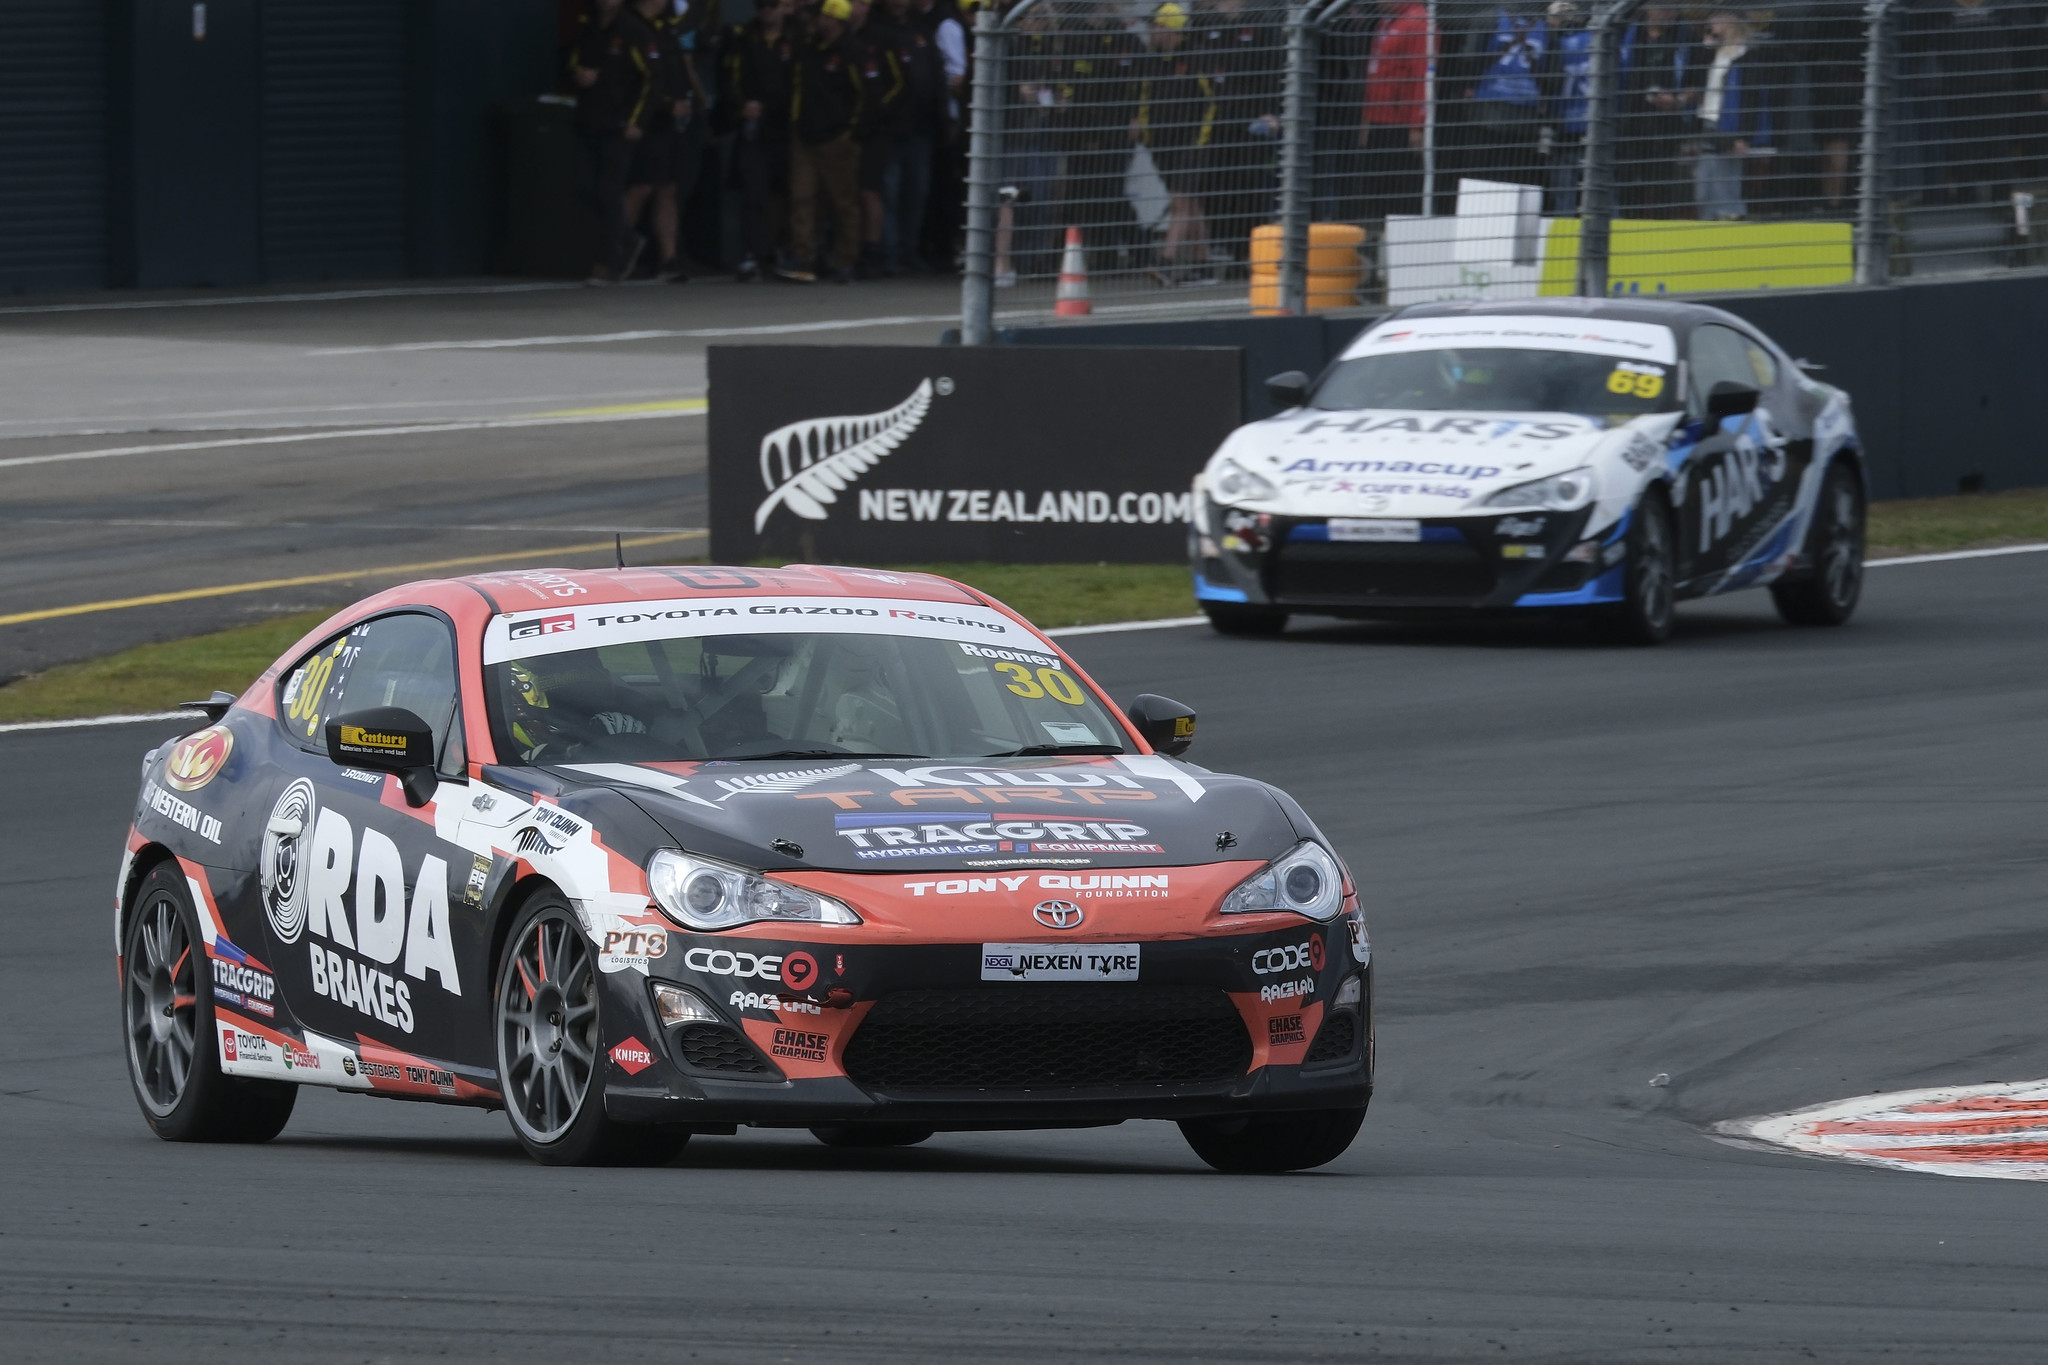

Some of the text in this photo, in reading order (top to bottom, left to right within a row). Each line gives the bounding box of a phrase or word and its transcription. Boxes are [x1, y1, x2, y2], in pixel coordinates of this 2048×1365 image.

[1606, 369, 1664, 398] 69
[1299, 416, 1582, 439] HARTS
[1283, 458, 1501, 480] Armacup
[1359, 482, 1471, 499] cure kids
[510, 606, 1006, 640] GR TOYOTA GAZOO Racing
[958, 643, 1062, 670] Rooney
[289, 655, 334, 720] 30
[994, 662, 1085, 706] 30
[345, 726, 407, 748] Century
[341, 768, 382, 785] J.ROONEY
[795, 788, 1157, 810] TARP
[150, 786, 202, 832] WESTERN
[200, 814, 222, 845] OIL
[532, 806, 583, 837] TONY QUINN
[837, 821, 1149, 848] TRACGRIP
[857, 842, 1159, 859] HYDRAULICS EQUIPMENT
[903, 875, 1168, 896] TONY QUINN
[1075, 890, 1169, 899] FOUNDATION
[308, 806, 462, 997] RDA
[600, 931, 667, 958] PTS
[611, 957, 648, 965] LOGISTICS
[1019, 955, 1082, 970] NEXEN
[1088, 955, 1137, 970] TYRE
[212, 958, 275, 1000] TRACGRIP
[309, 942, 414, 1034] BRAKES
[1269, 1016, 1303, 1033] CHASE
[237, 1035, 267, 1050] TOYOTA
[775, 1029, 829, 1050] CHASE
[1270, 1031, 1305, 1045] GRAPHICS
[239, 1051, 257, 1060] Financial
[293, 1047, 321, 1069] Castrol
[615, 1048, 650, 1064] KNIPEX
[772, 1045, 825, 1062] GRAPHICS
[359, 1062, 400, 1080] BESTBARS
[406, 1066, 455, 1087] TONY QUINN
